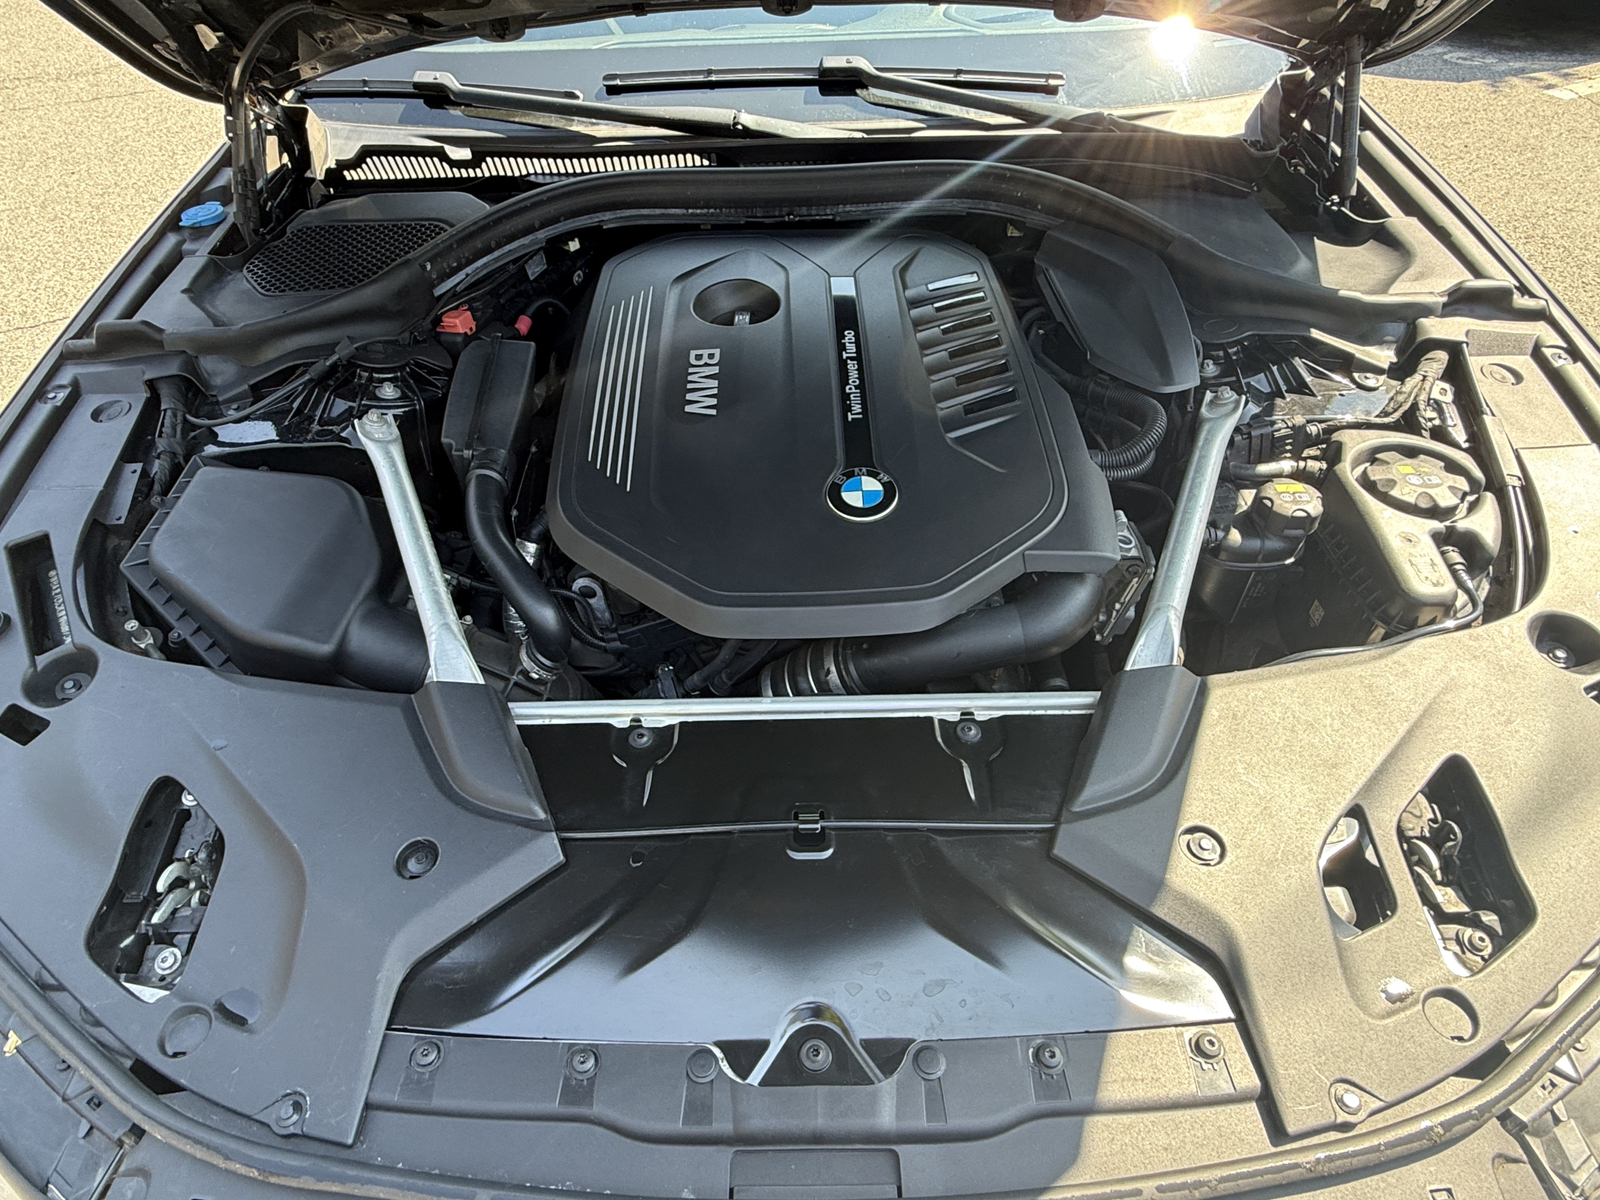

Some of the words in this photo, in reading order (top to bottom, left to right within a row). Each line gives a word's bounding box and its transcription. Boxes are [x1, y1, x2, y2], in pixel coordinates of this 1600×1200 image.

[842, 329, 857, 359] Turbo
[684, 348, 721, 416] BMW
[846, 360, 863, 421] TwinPower
[834, 468, 891, 485] BMW
